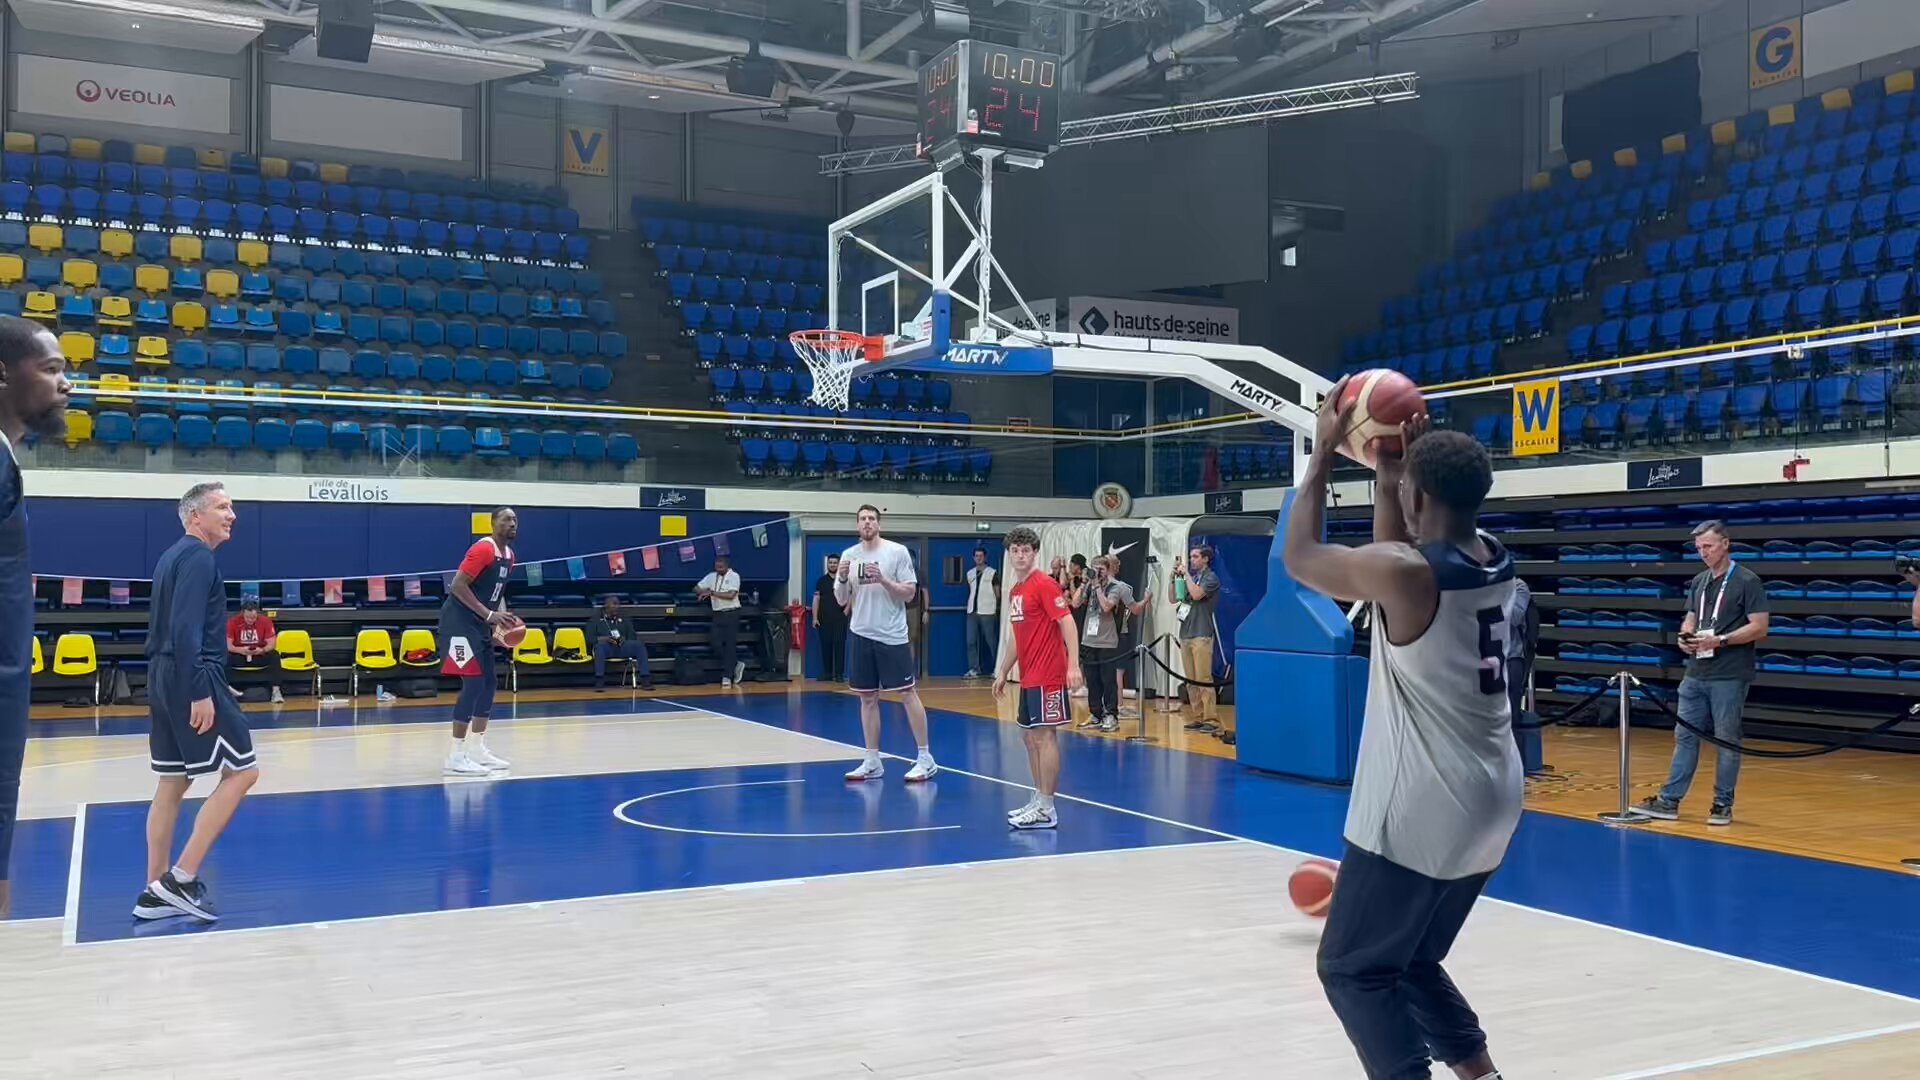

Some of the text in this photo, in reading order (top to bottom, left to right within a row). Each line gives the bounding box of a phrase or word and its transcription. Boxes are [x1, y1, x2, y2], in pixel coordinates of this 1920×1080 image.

[1755, 26, 1794, 74] G
[982, 51, 1056, 88] 10:00
[105, 87, 176, 107] VEOLIA
[984, 86, 1041, 132] 24
[569, 129, 602, 165] V
[1230, 379, 1282, 411] MARTY
[1517, 387, 1556, 433] W
[308, 483, 389, 501] Levallois
[313, 479, 349, 488] ville de
[1476, 604, 1507, 695] 5
[1046, 690, 1061, 721] USA
